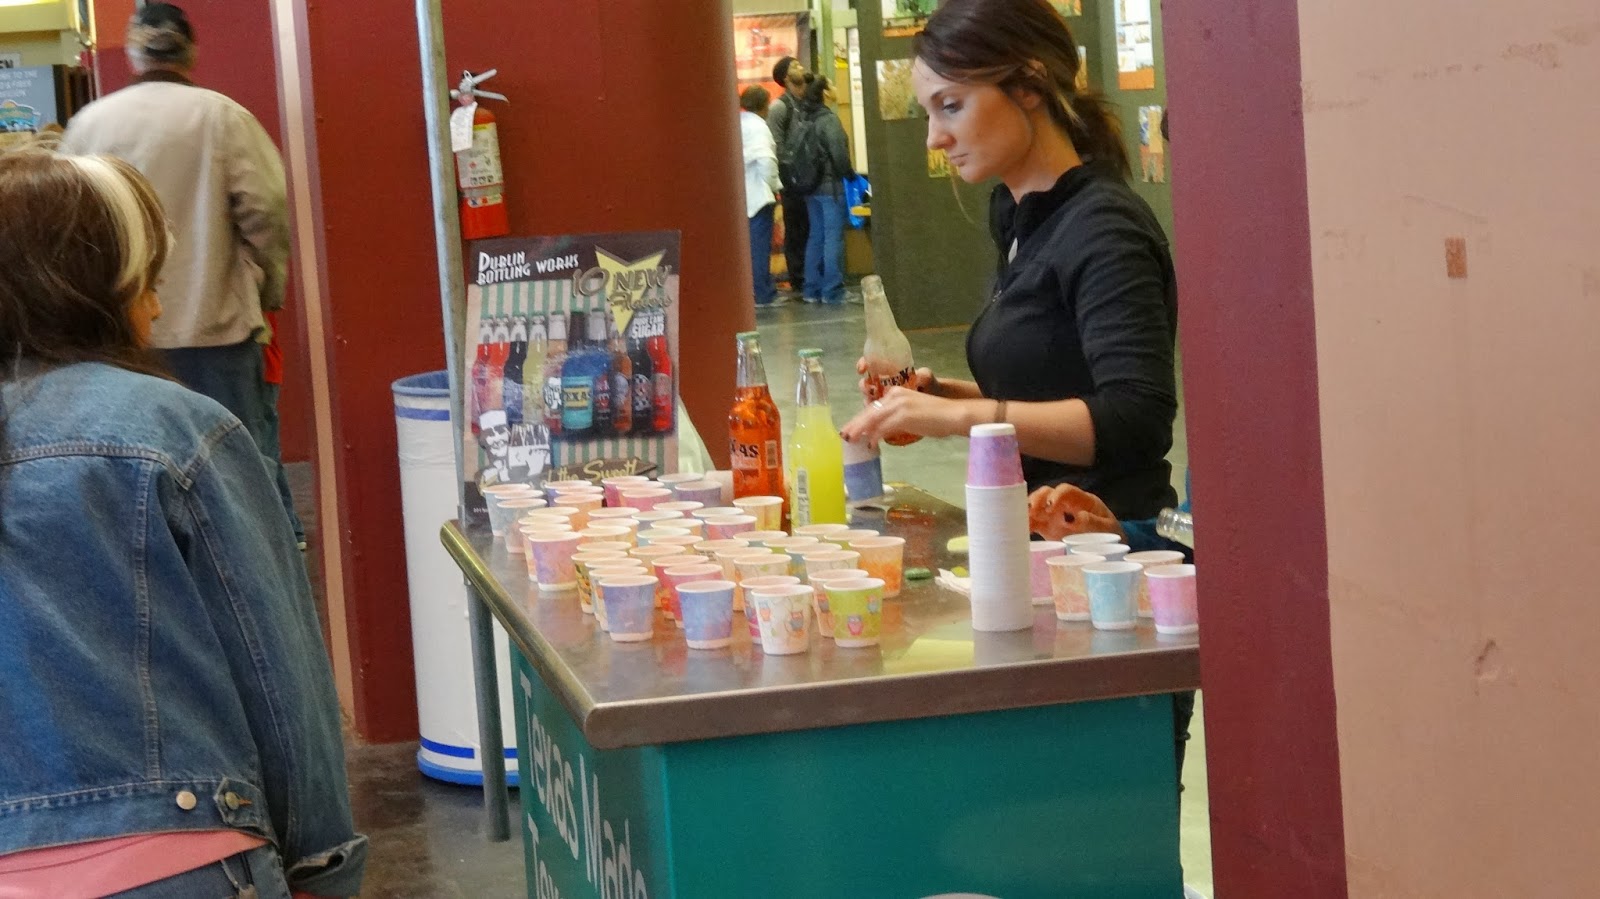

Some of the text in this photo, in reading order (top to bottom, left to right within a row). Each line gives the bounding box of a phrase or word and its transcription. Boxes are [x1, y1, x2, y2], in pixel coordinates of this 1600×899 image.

[476, 253, 580, 286] BOTTLING WORKS
[479, 251, 526, 272] DUBLIN
[572, 264, 672, 297] 10 NEW
[631, 322, 665, 340] SUGAR
[520, 669, 579, 860] Texas
